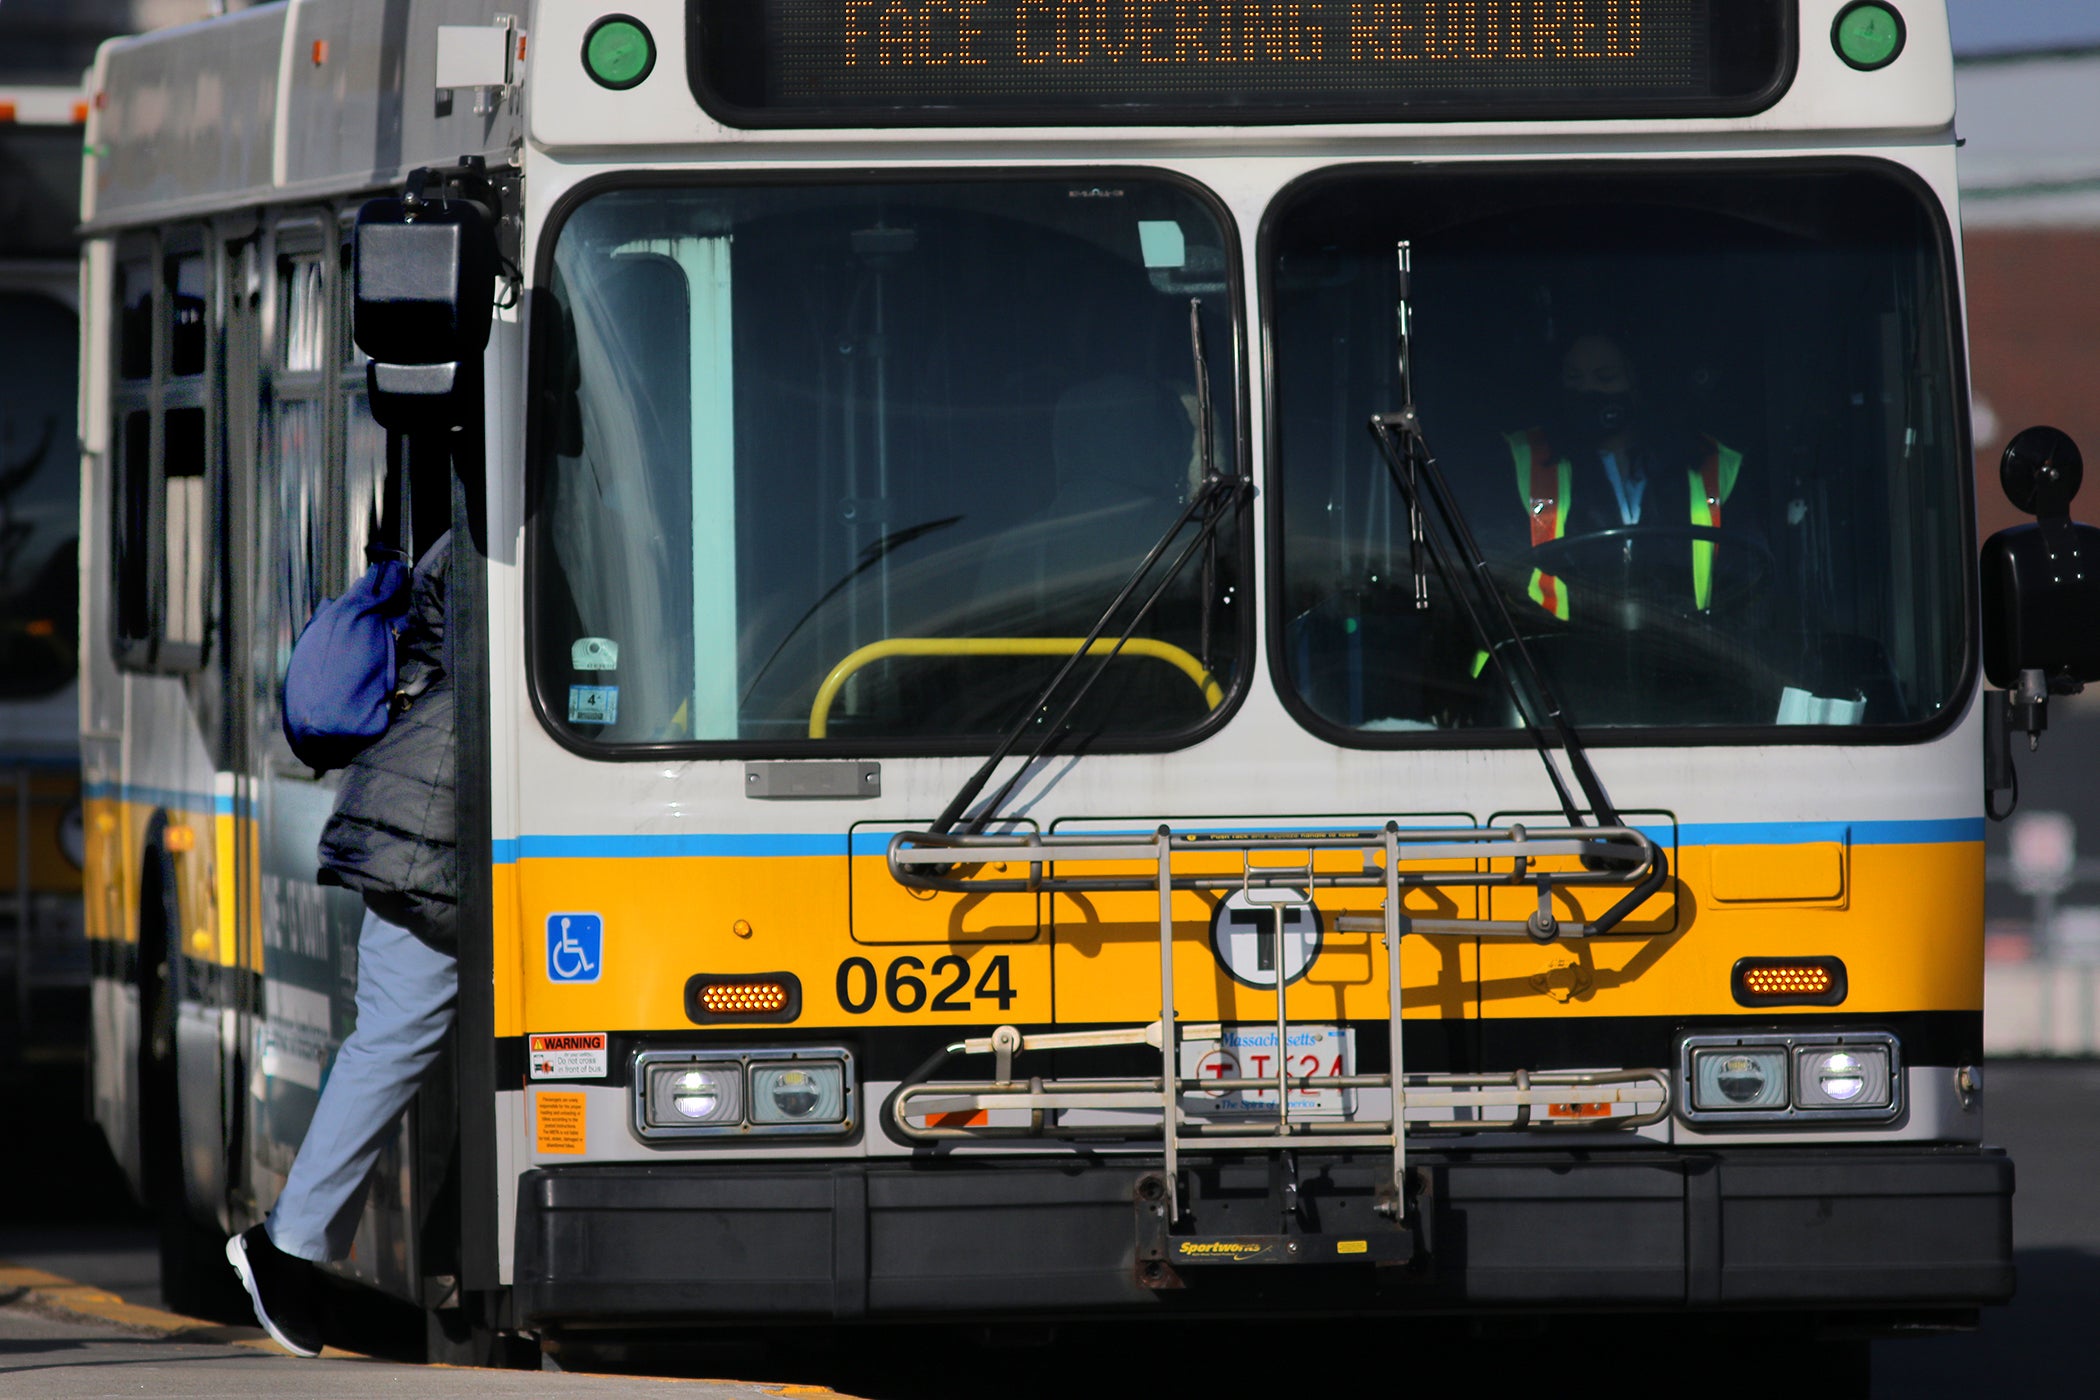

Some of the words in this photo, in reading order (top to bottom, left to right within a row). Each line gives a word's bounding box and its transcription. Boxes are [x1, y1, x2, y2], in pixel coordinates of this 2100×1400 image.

[845, 0, 987, 65] FACE
[1016, 0, 1323, 64] COVERING
[1350, 0, 1641, 60] REQUIRED
[1230, 908, 1301, 971] T
[835, 954, 1018, 1015] 0624
[544, 1037, 601, 1050] WARNING
[1221, 1032, 1316, 1047] Massachsetts
[557, 1057, 566, 1065] Do
[567, 1057, 578, 1065] not
[579, 1057, 596, 1065] cross
[1222, 1100, 1239, 1110] The
